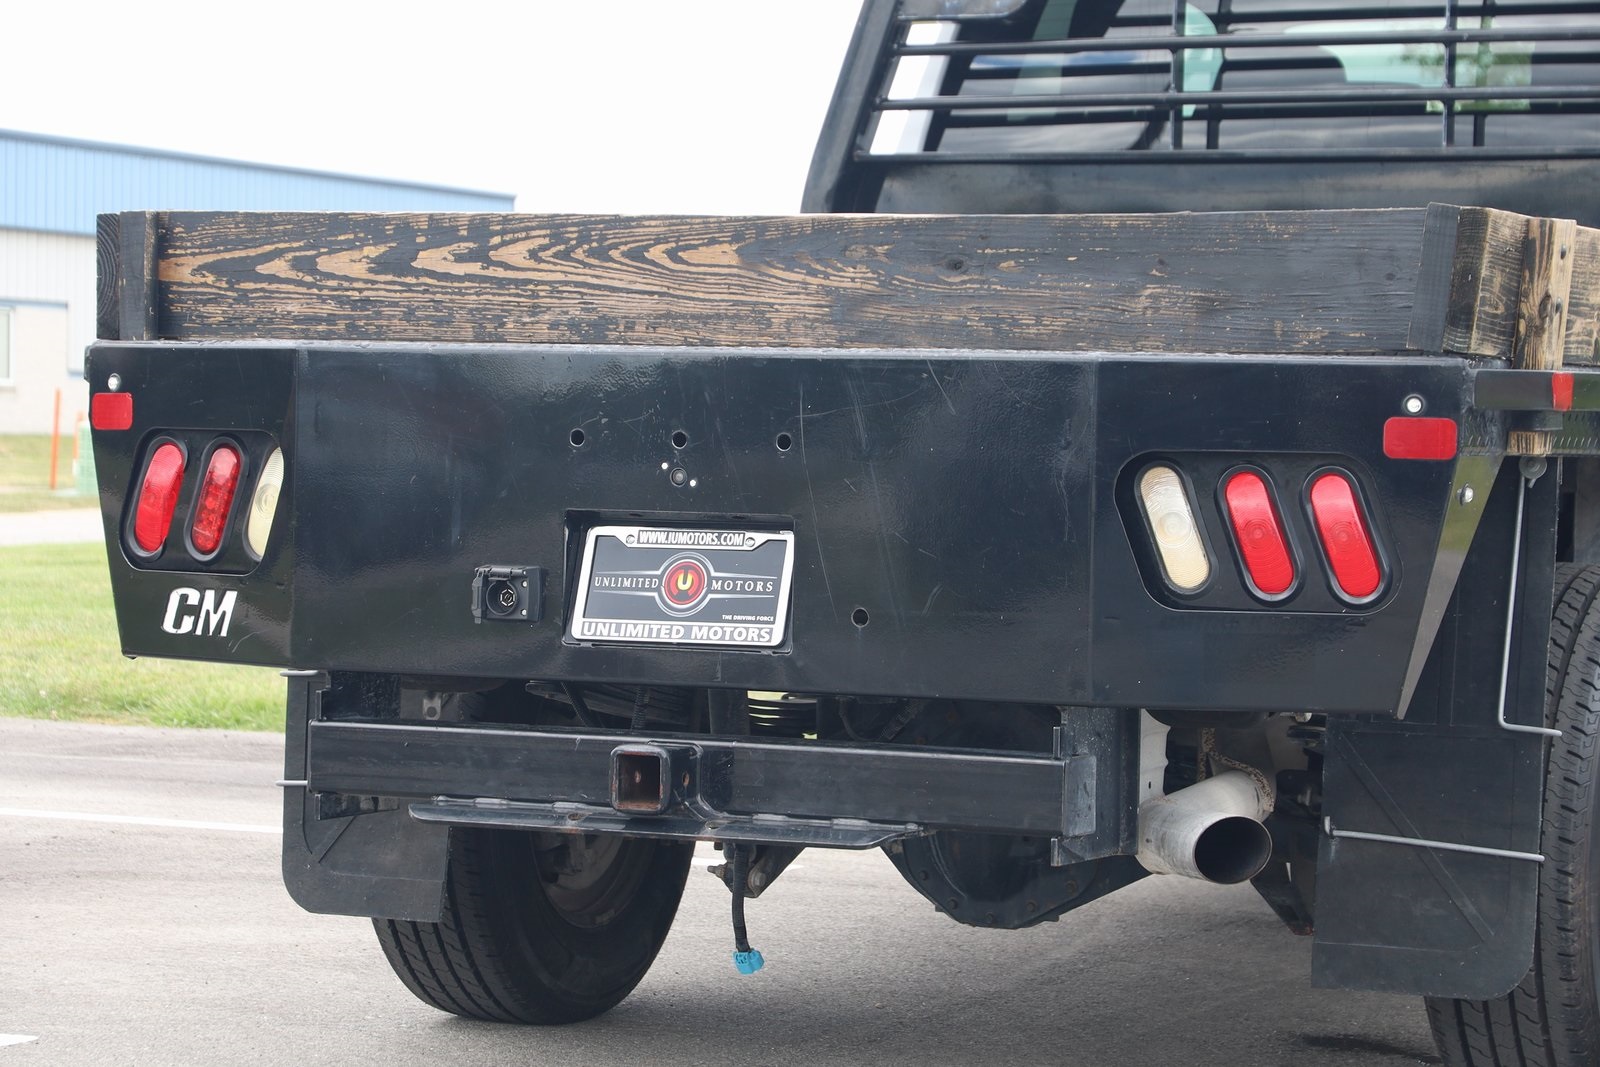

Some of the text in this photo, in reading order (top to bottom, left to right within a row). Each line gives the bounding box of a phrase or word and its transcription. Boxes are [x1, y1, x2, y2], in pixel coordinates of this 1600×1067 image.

[639, 531, 744, 546] WWW.IUMOTORS.COM
[594, 576, 774, 592] UNLIMITED MOTORS
[162, 587, 238, 637] CM
[583, 621, 773, 642] UNLIMITED MOTORS
